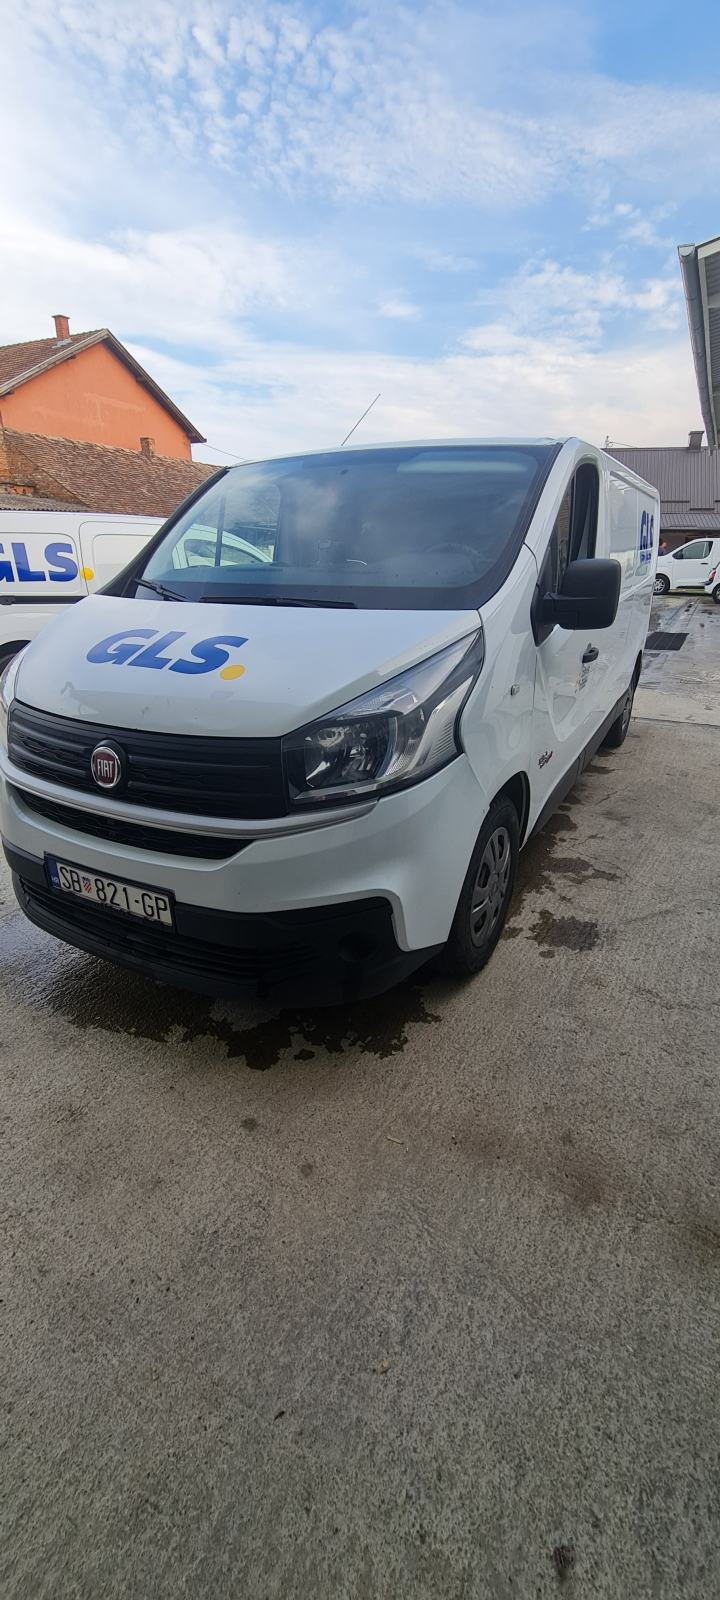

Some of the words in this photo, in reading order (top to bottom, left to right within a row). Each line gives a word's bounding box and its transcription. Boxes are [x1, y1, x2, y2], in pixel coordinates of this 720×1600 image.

[97, 758, 114, 778] FIAT
[59, 866, 82, 893] SB
[94, 878, 168, 920] 821-GP
